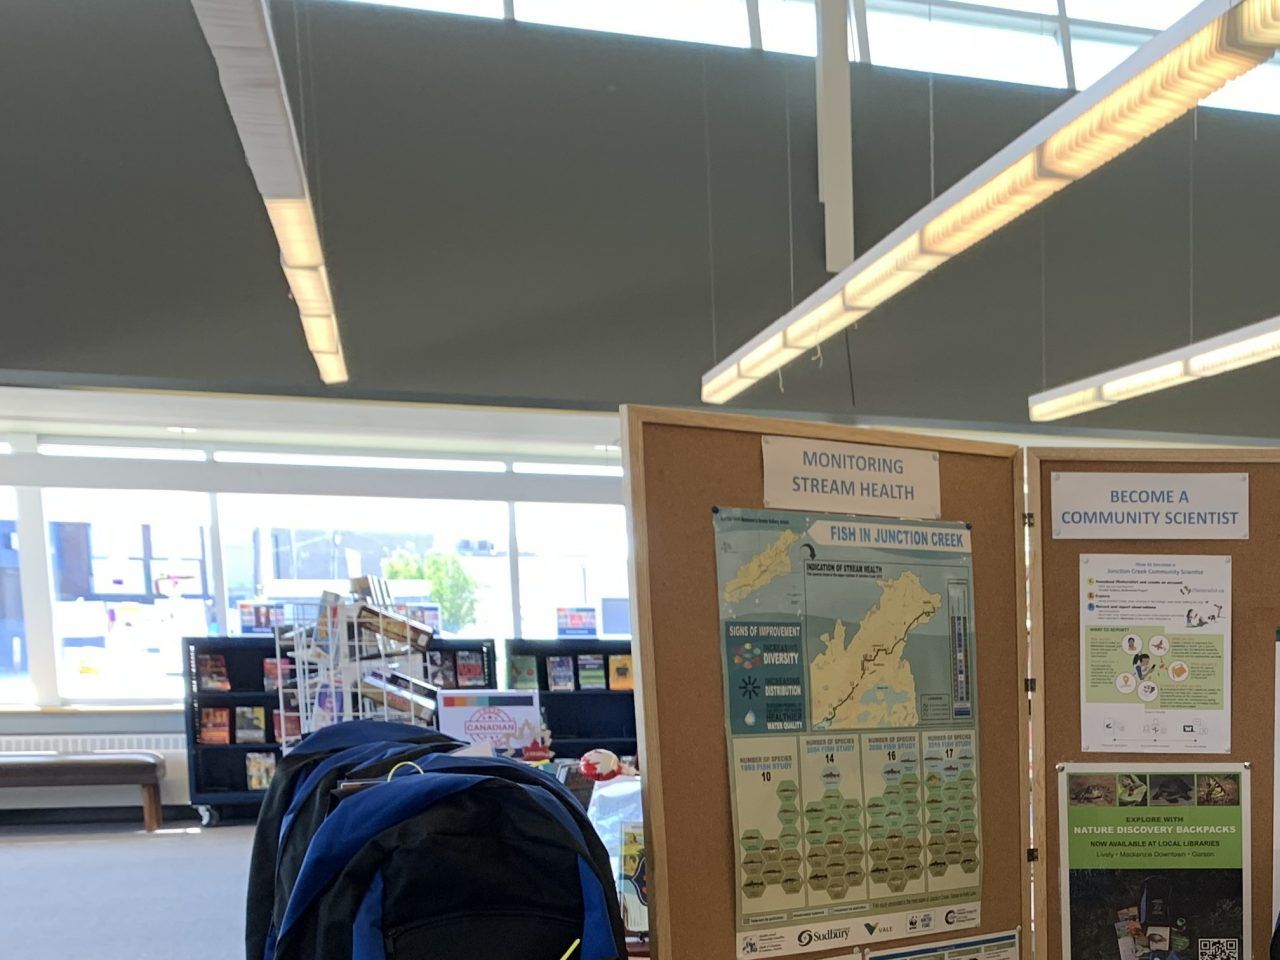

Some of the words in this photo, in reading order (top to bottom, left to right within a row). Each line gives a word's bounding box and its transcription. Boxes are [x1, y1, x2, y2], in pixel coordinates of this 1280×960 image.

[803, 451, 904, 474] MONITORING
[792, 476, 855, 496] STREAM
[860, 482, 915, 500] HEALTH
[1110, 490, 1174, 503] BECOME
[1178, 490, 1190, 503] A
[1061, 511, 1160, 525] COMMUNITY
[1164, 511, 1239, 525] SCIENTIST
[830, 526, 857, 542] FISH
[860, 528, 871, 542] IN
[874, 529, 928, 545] JUNCTION
[932, 532, 964, 548] CREEK
[806, 563, 834, 572] INDICATION
[729, 626, 748, 636] SIGNS
[750, 626, 758, 636] OF
[759, 626, 800, 637] IMPROVEMENT
[763, 652, 799, 664] DIVERSITY
[765, 685, 801, 696] DISTRIBUTION
[466, 723, 514, 731] CANADIAN
[825, 753, 834, 764] 14
[887, 751, 896, 761] 16
[945, 748, 954, 758] 17
[761, 771, 771, 782] 10
[1074, 826, 1114, 834] NATURE
[1117, 826, 1173, 834] DISCOVERY
[813, 929, 850, 942] Sudbury
[878, 926, 893, 934] VALE
